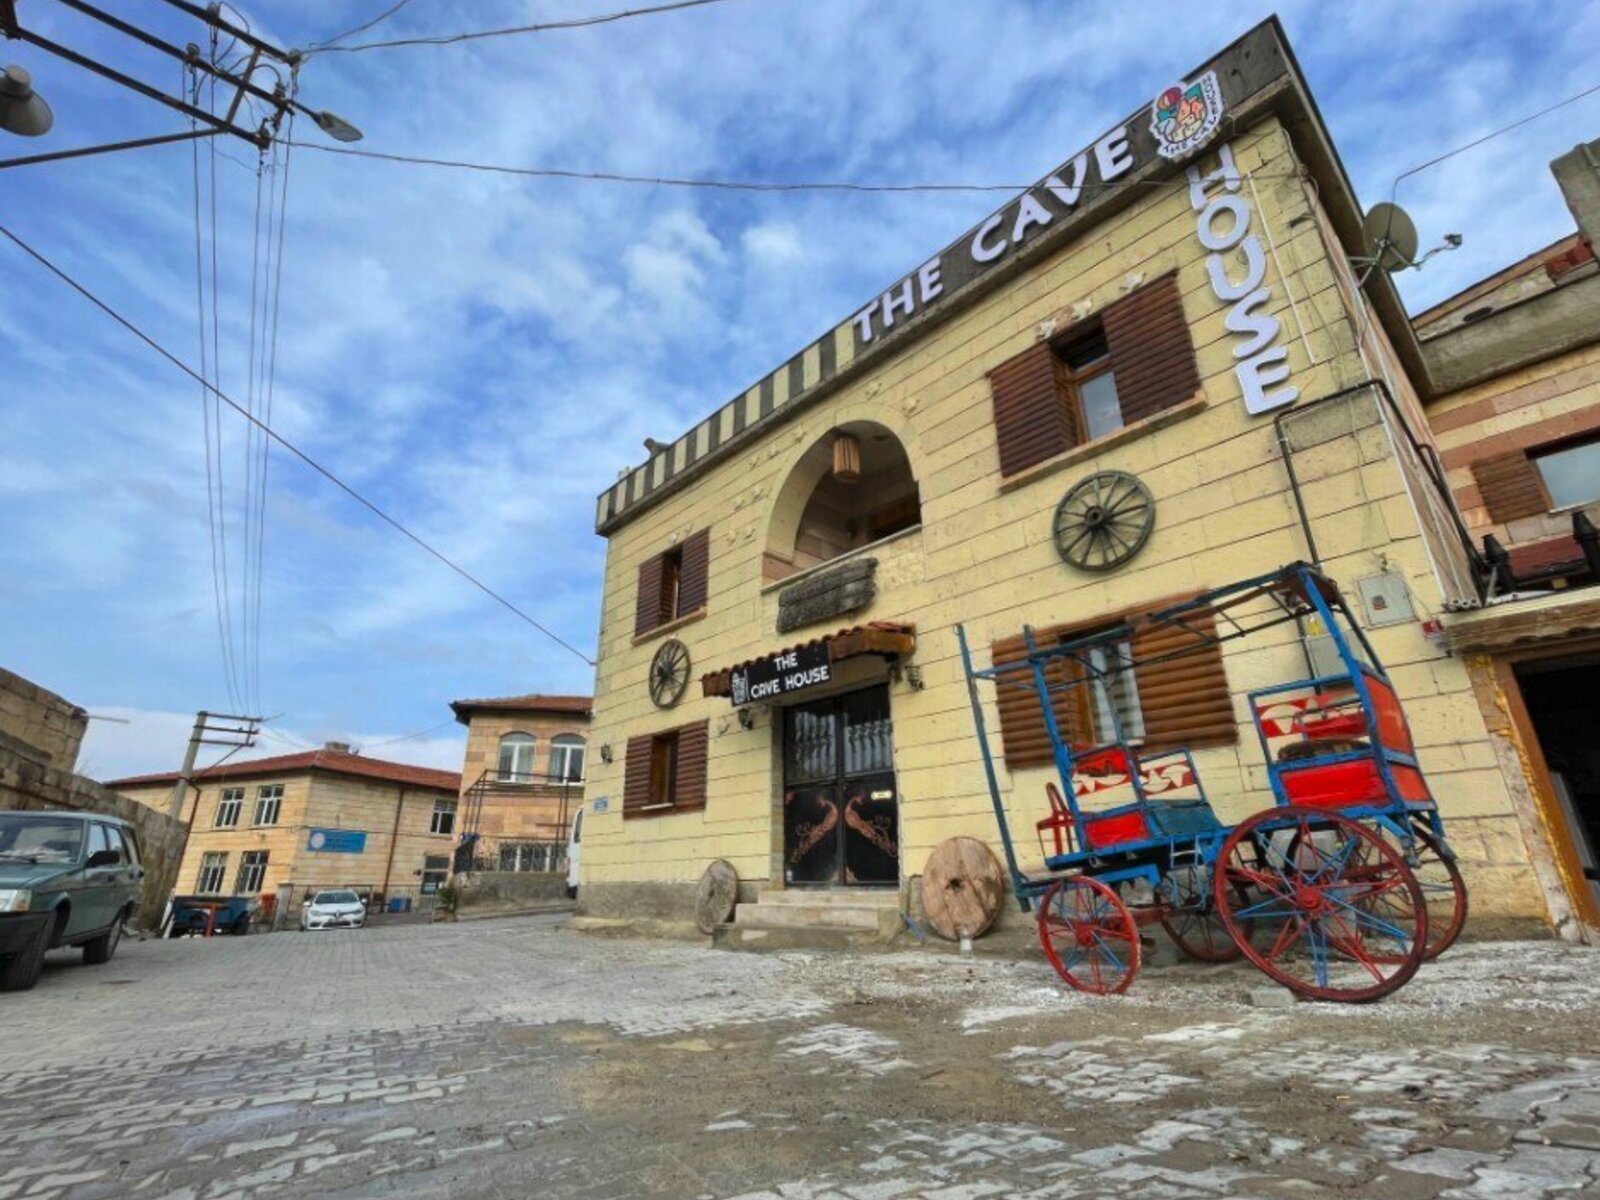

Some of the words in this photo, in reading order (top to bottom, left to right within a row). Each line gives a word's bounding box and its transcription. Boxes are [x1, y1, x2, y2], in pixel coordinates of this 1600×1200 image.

[853, 258, 943, 342] THE
[971, 126, 1134, 263] CAVE
[1185, 143, 1298, 415] HOUSE
[751, 678, 781, 698] CAVE
[785, 665, 830, 688] HOUSE
[774, 652, 798, 671] THE
